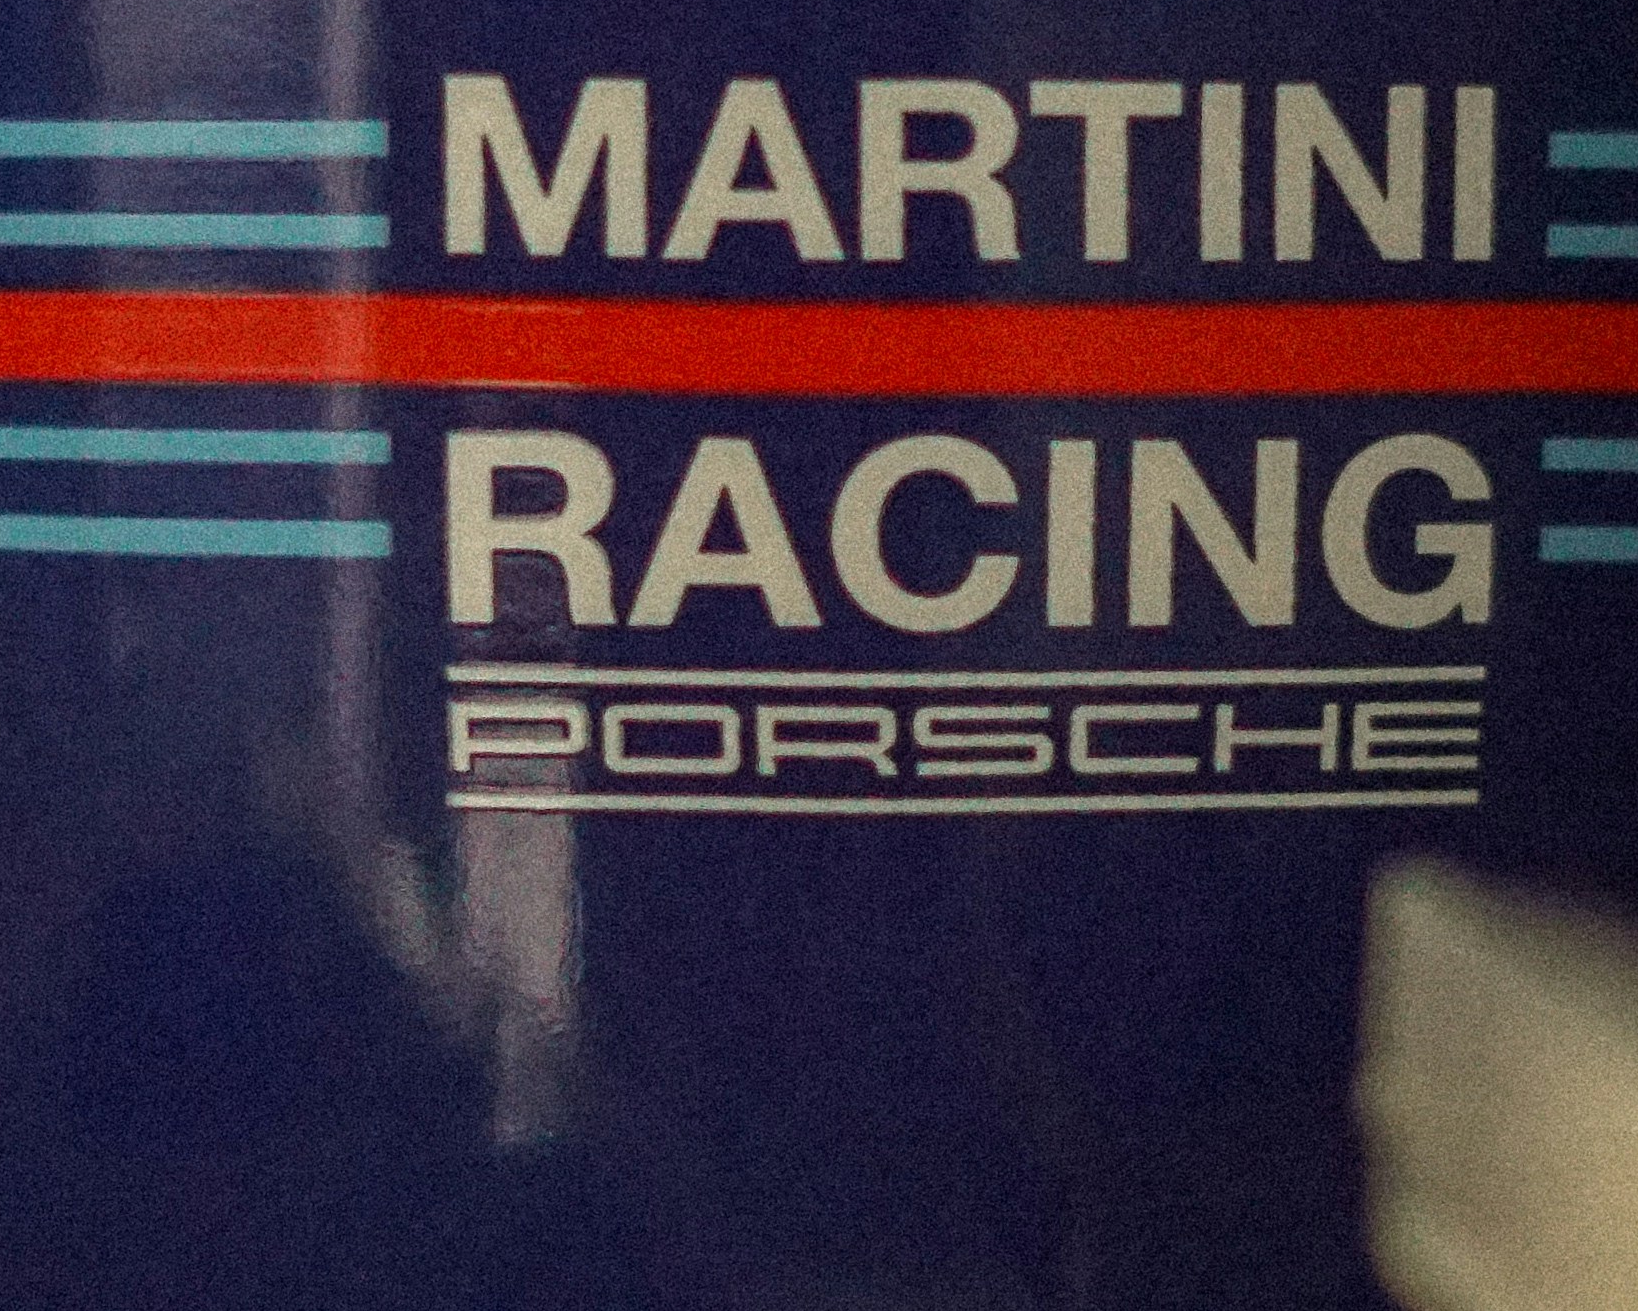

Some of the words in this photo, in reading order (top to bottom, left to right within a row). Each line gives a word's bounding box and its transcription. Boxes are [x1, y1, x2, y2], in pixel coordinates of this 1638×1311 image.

[443, 73, 1496, 262] MARTINI
[445, 429, 1494, 632] RACING
[447, 696, 1481, 777] PORSCHE
